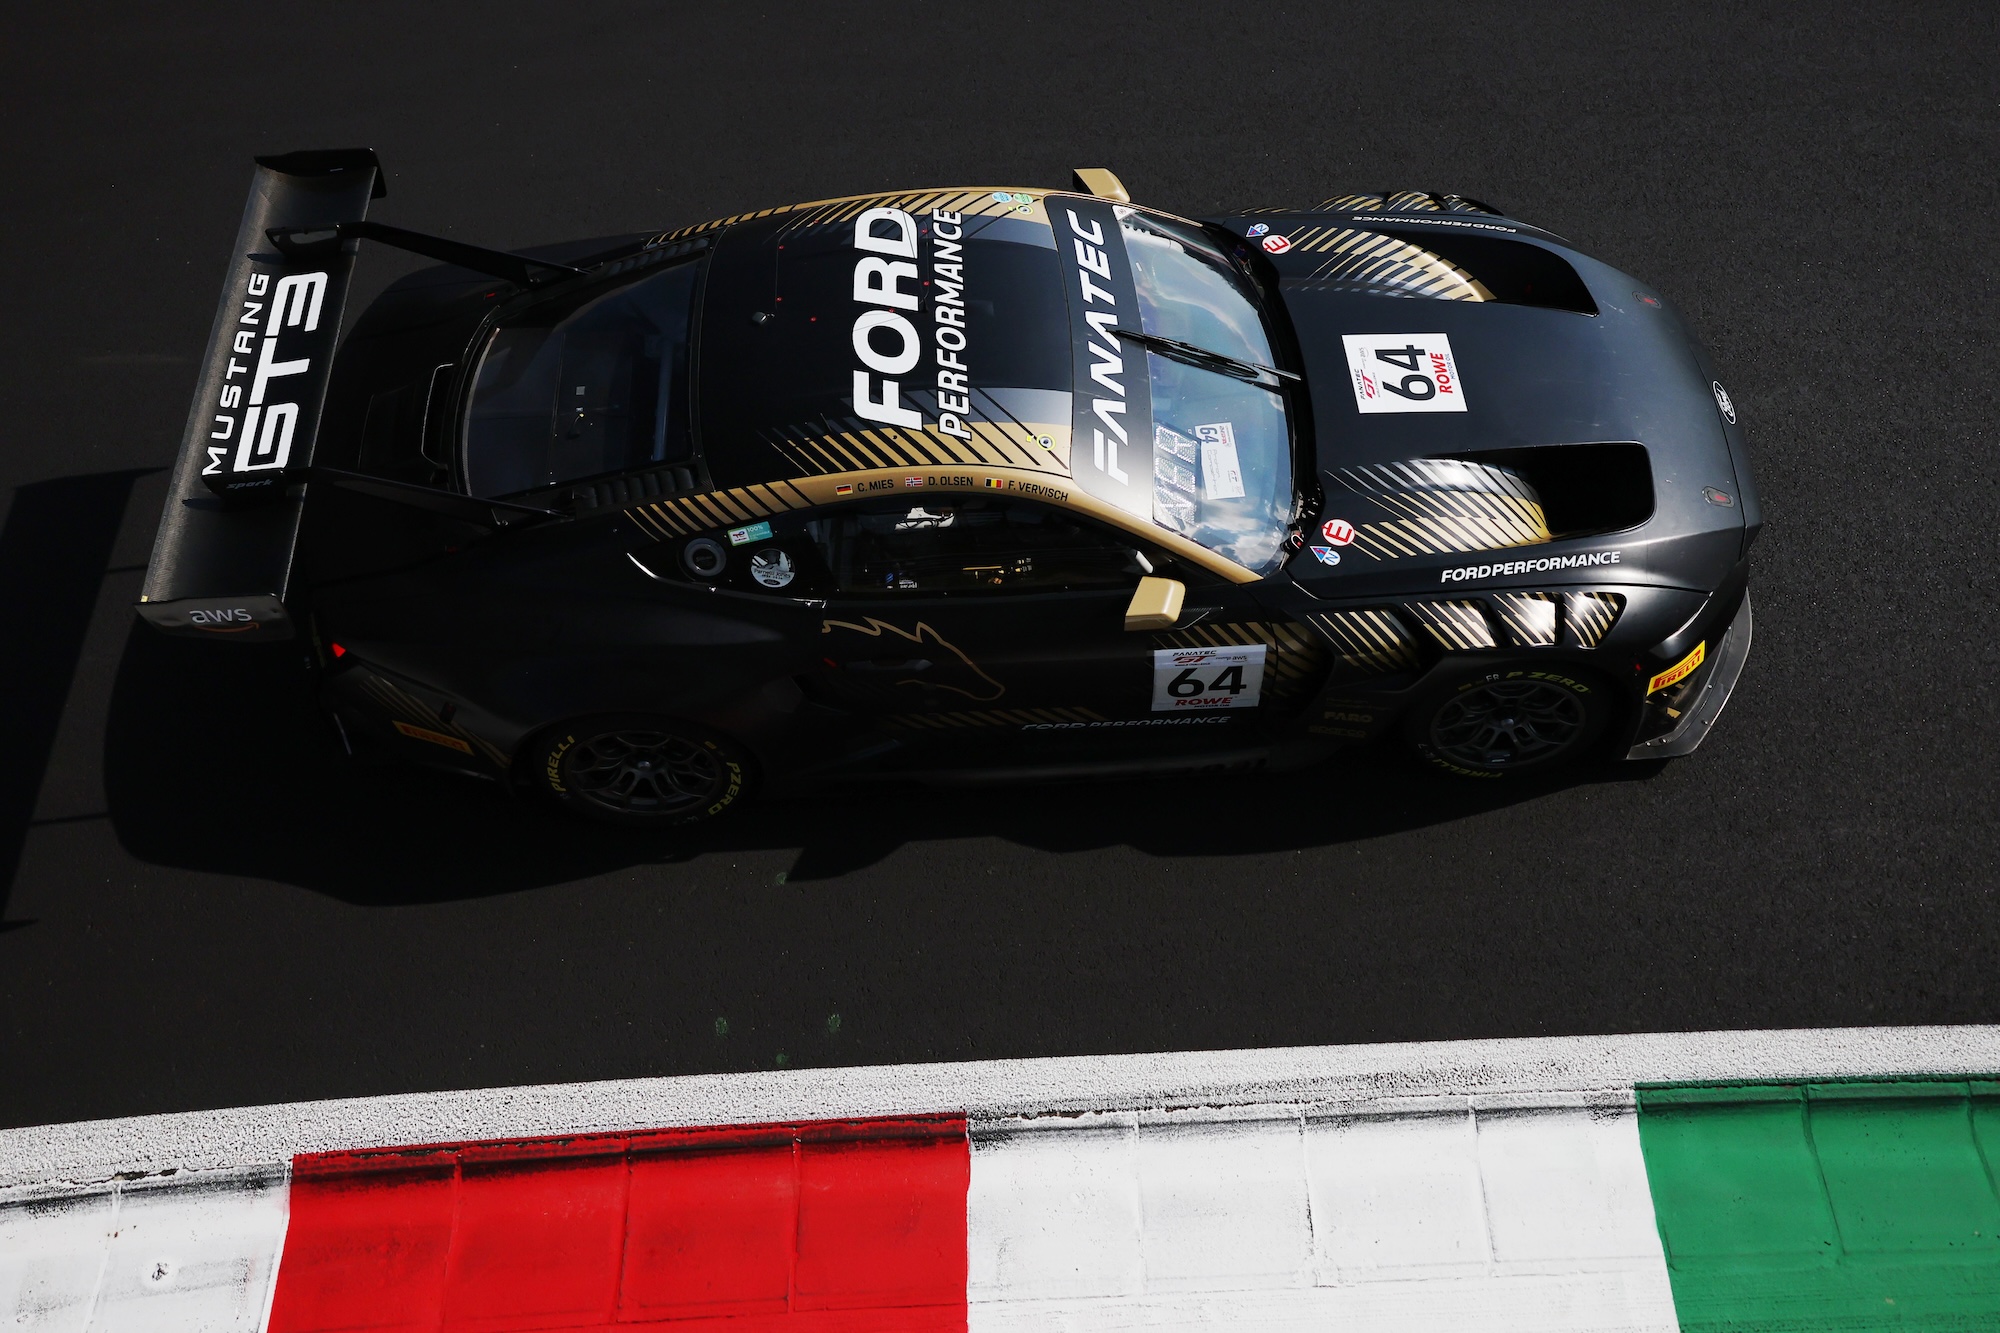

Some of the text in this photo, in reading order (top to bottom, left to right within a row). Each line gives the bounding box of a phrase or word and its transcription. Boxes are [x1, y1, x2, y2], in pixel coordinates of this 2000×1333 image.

[852, 206, 923, 432] FORD
[932, 207, 972, 441] PERFORMANCE
[1067, 208, 1129, 487] FANATEC
[202, 272, 270, 475] MUSTANG
[233, 271, 328, 472] GT3
[1354, 368, 1365, 400] FANATEC
[1374, 344, 1436, 401] 64
[1429, 352, 1453, 394] ROWE
[1446, 361, 1456, 380] MOTOR
[1199, 427, 1219, 444] 64
[226, 478, 273, 490] spark
[857, 479, 894, 493] C. MIES
[928, 476, 974, 486] D. OLSEN
[1008, 480, 1069, 502] F. VERVISCH
[189, 608, 253, 624] aws
[1173, 655, 1216, 664] GT
[1653, 649, 1701, 689] PIRELLI
[1168, 666, 1247, 697] 64
[1527, 671, 1590, 694] ZERO
[1175, 697, 1233, 706] ROWE
[1021, 716, 1232, 731] FORD PERFORMANCE
[546, 734, 576, 792] PIRELLI
